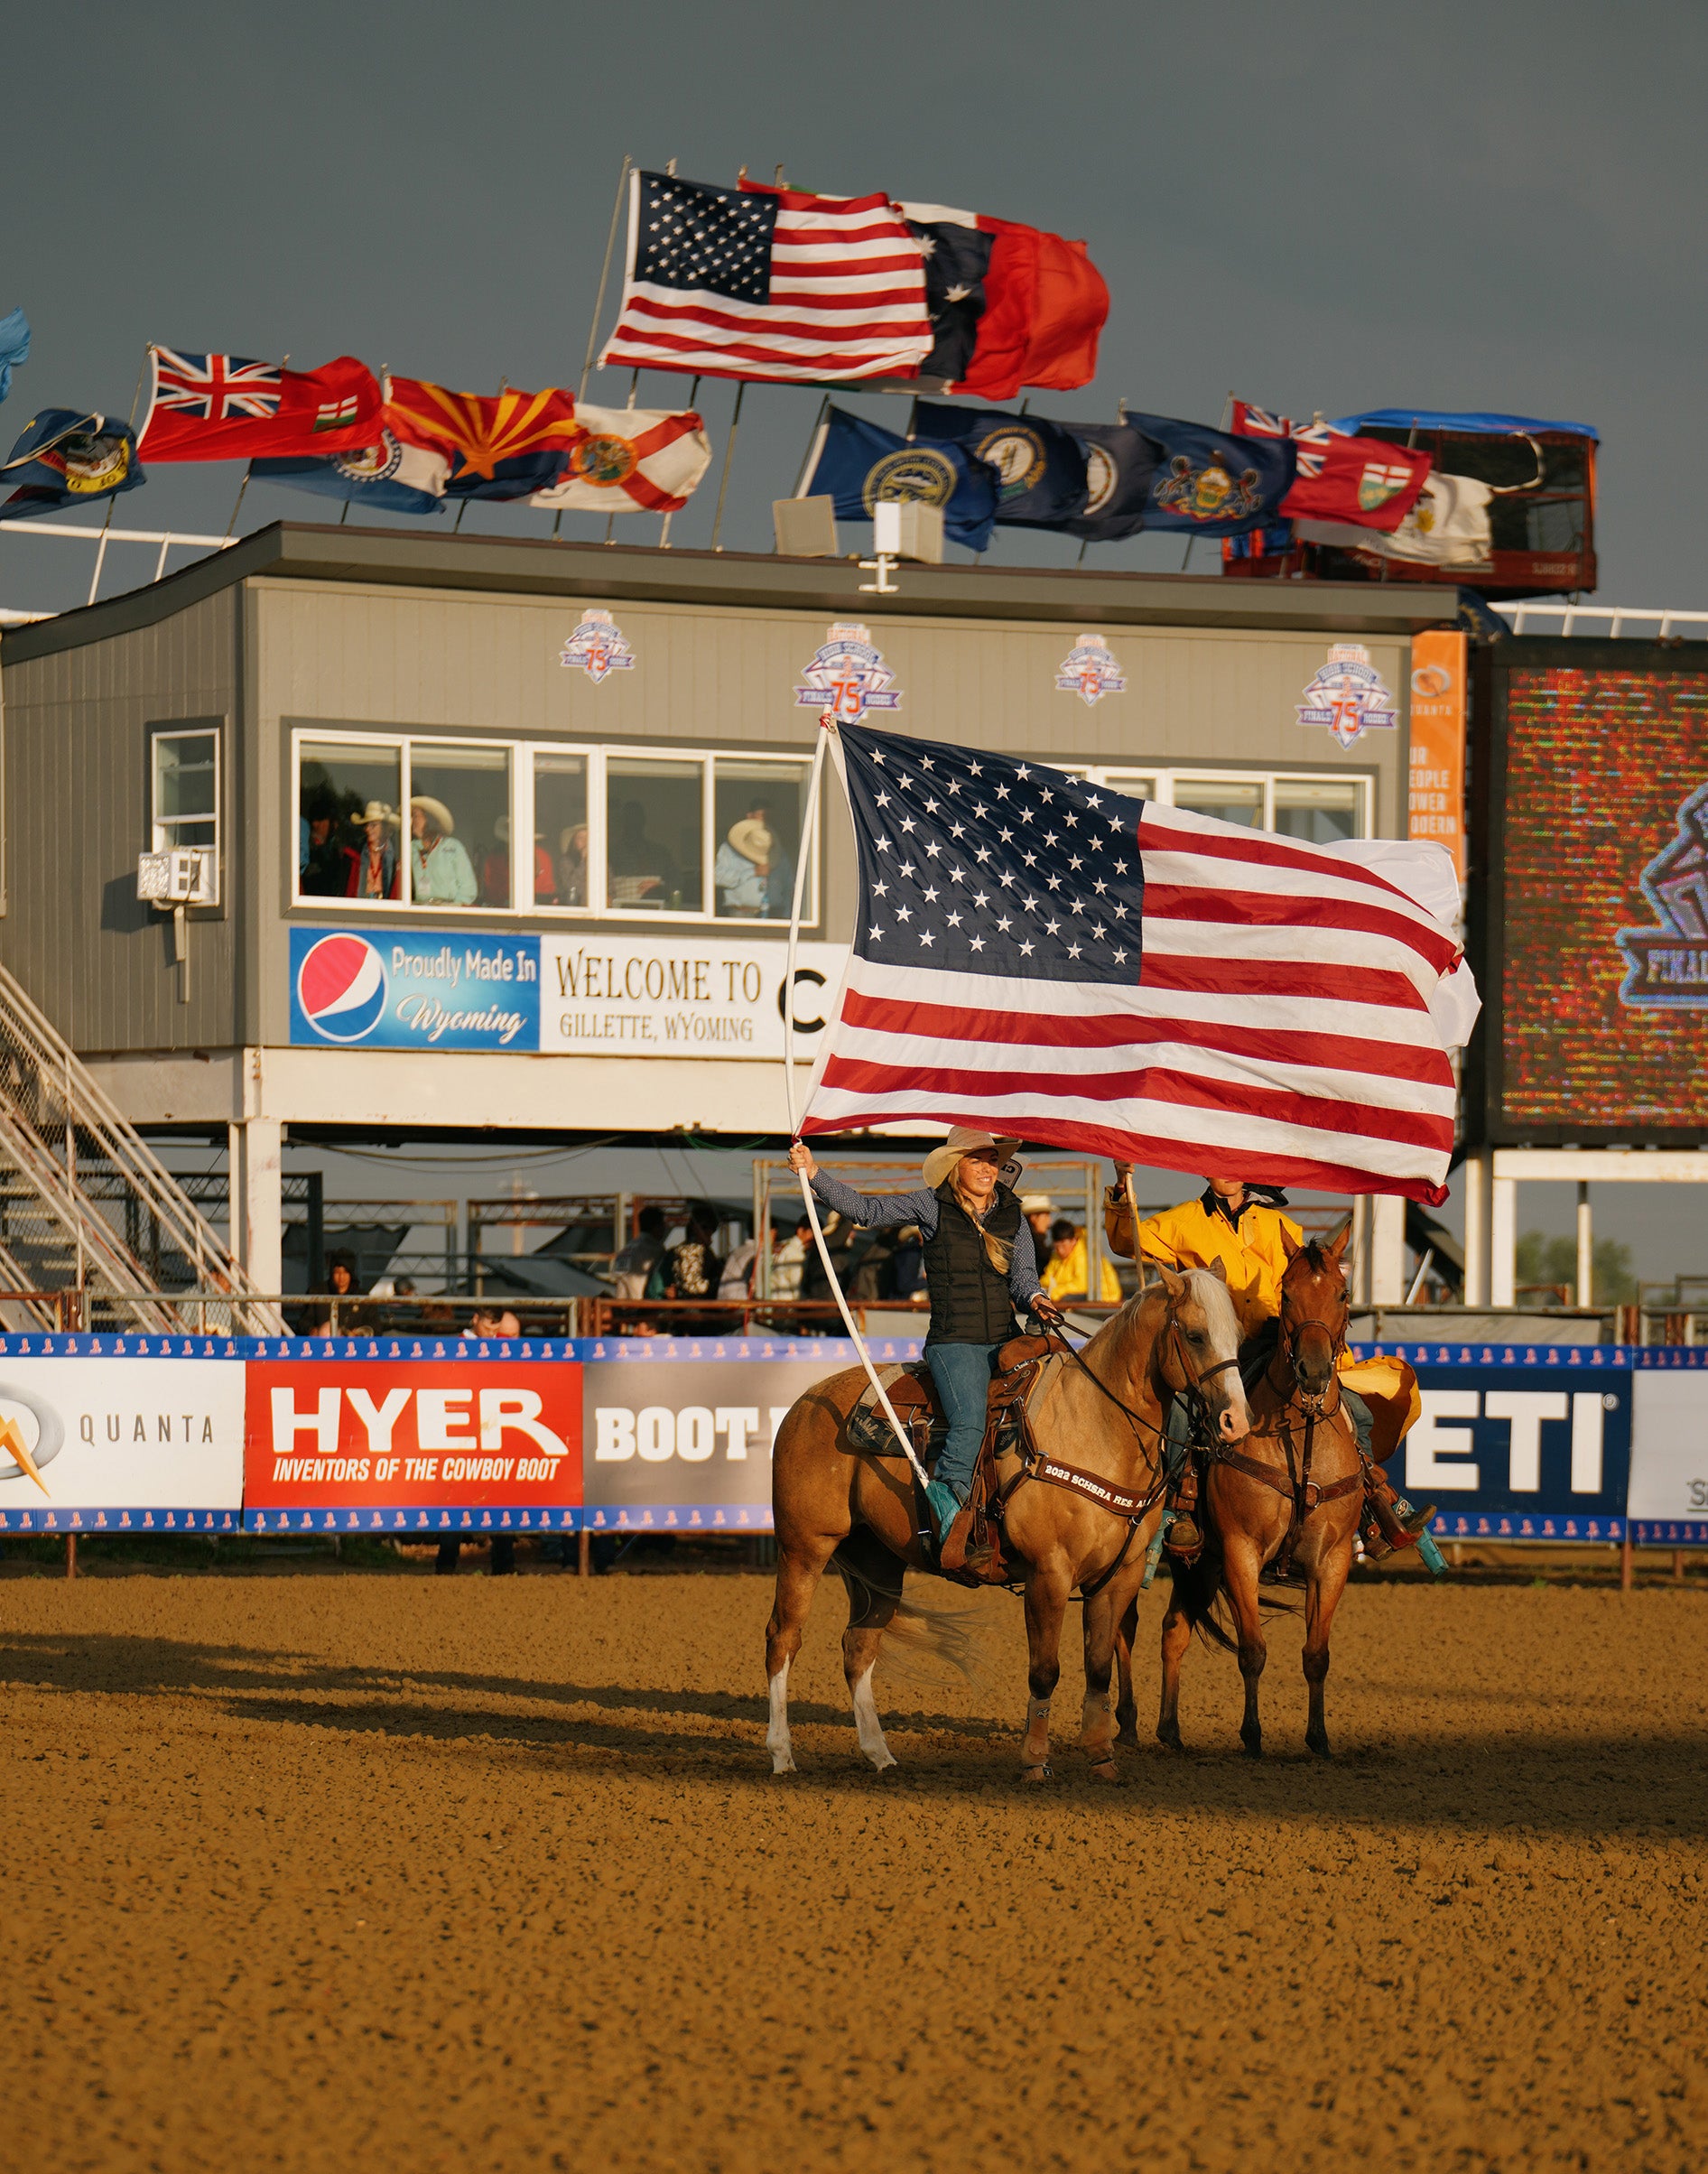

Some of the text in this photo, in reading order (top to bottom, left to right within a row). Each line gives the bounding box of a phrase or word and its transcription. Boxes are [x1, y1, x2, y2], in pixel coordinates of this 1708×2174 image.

[587, 649, 606, 671] 75
[831, 681, 860, 713] 75
[1080, 673, 1100, 694] 75
[1331, 701, 1359, 732] 75
[1410, 704, 1452, 716] UANTA
[1409, 747, 1428, 766] UR
[1409, 769, 1450, 789] EOPLE
[1409, 792, 1446, 812] OWER
[392, 945, 536, 989] Proudly Made In
[555, 946, 761, 1003] WELCOME TO
[395, 993, 527, 1045] Wyoming
[560, 1011, 753, 1042] GILLETTE, WYOMING
[79, 1414, 213, 1446] QUANTA
[271, 1387, 570, 1455] HYER
[595, 1406, 759, 1463] BOOT
[273, 1457, 561, 1482] INVENTORS OF THE COWBOY BOOT
[1044, 1464, 1071, 1482] 2022
